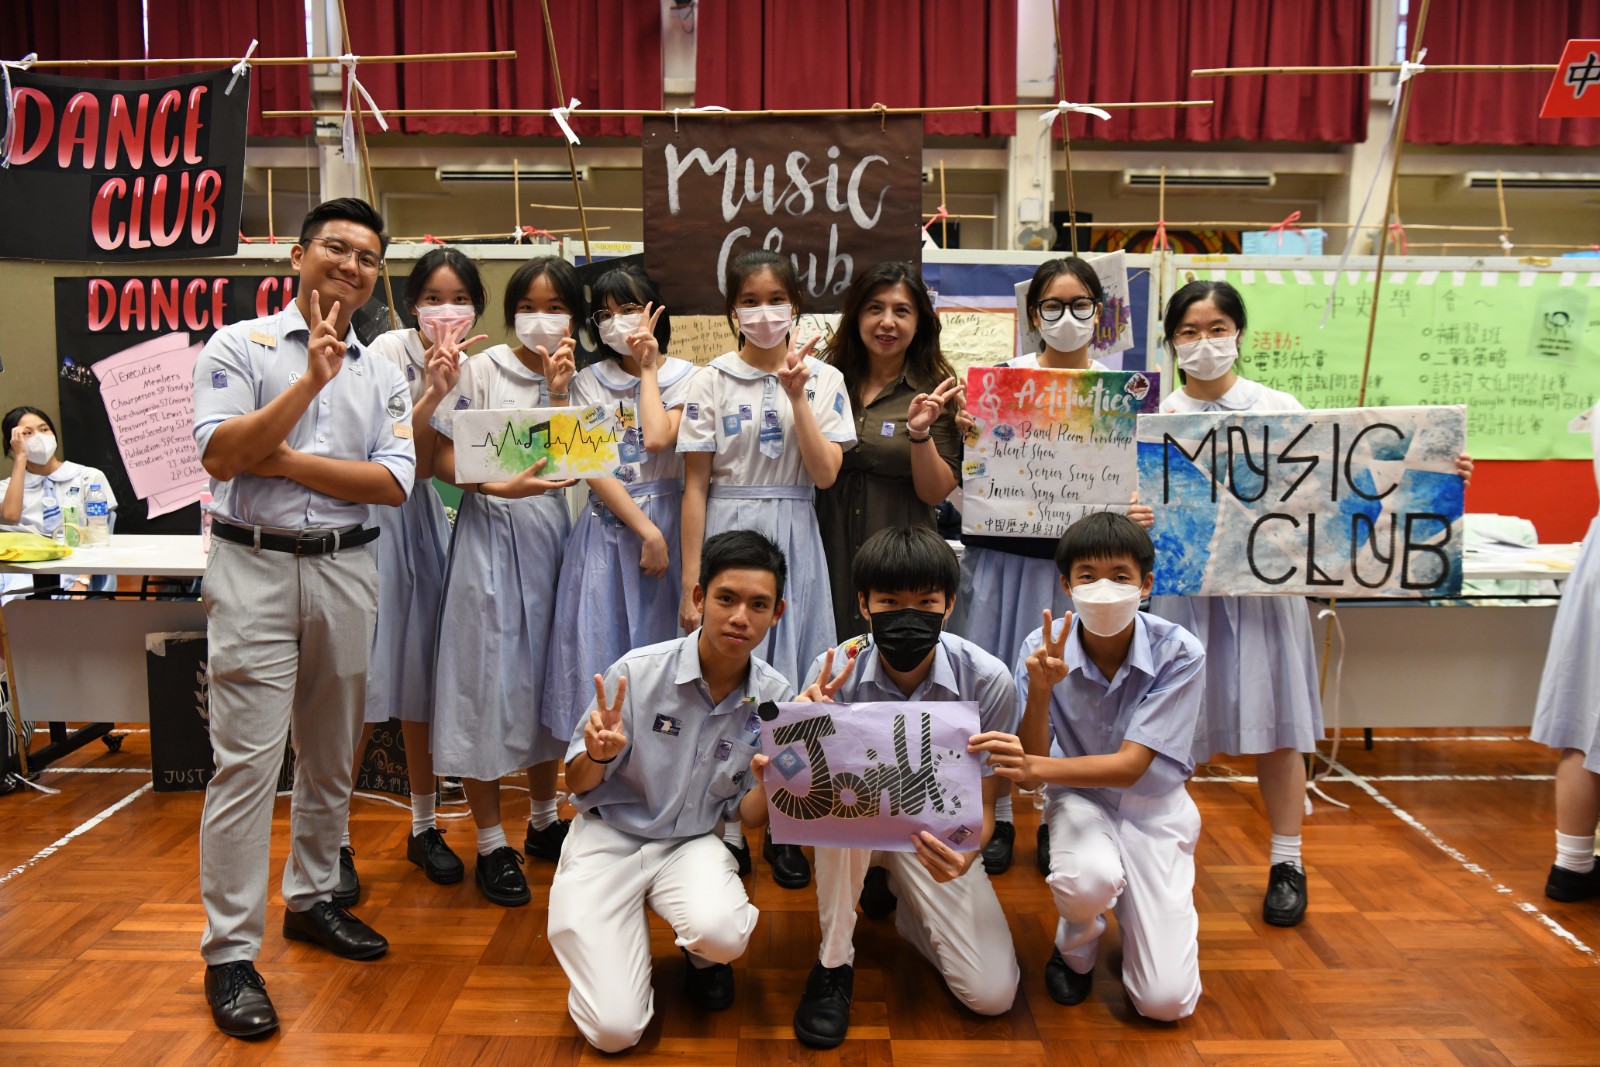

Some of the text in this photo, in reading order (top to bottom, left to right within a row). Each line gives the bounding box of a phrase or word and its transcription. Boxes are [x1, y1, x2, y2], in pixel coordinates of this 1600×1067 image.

[9, 85, 208, 169] DANCE
[91, 169, 222, 250] CLUB
[664, 143, 891, 230] Music
[88, 277, 230, 332] DANCE
[118, 363, 161, 382] Executive
[143, 373, 181, 388] Members
[1019, 420, 1053, 444] Band
[1163, 422, 1405, 504] MUSIC
[1247, 511, 1453, 590] CLUB
[164, 769, 205, 784] JUST
